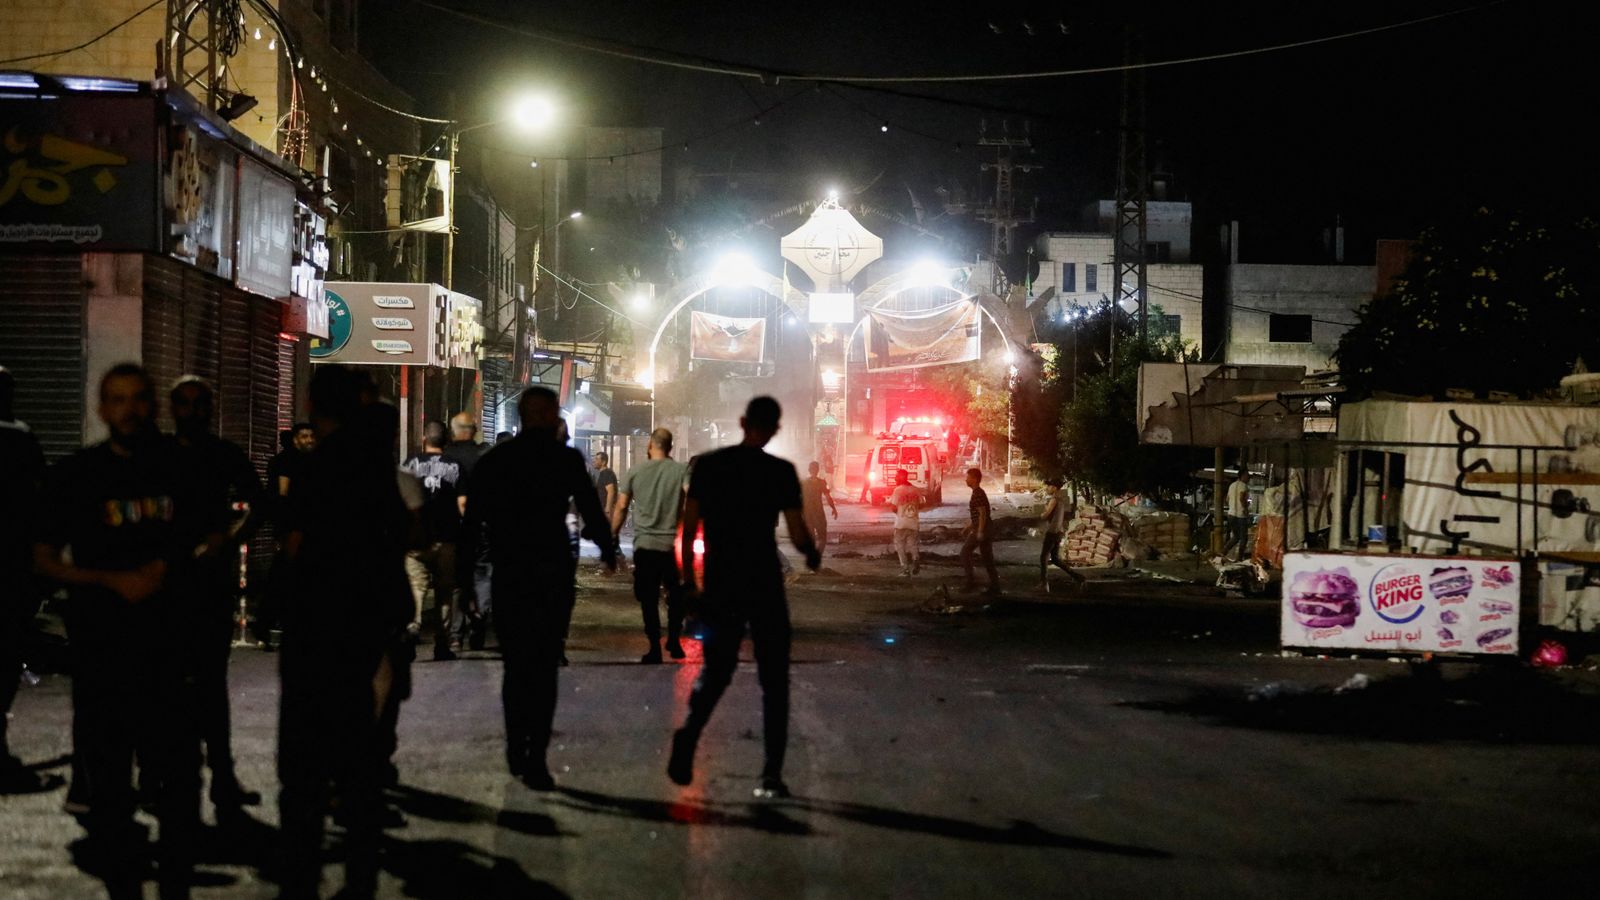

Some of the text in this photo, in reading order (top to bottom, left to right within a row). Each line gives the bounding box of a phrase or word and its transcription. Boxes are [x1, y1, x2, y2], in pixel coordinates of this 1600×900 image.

[378, 297, 409, 305] مكسرات
[1375, 574, 1421, 595] BURGER
[1376, 585, 1423, 610] KING
